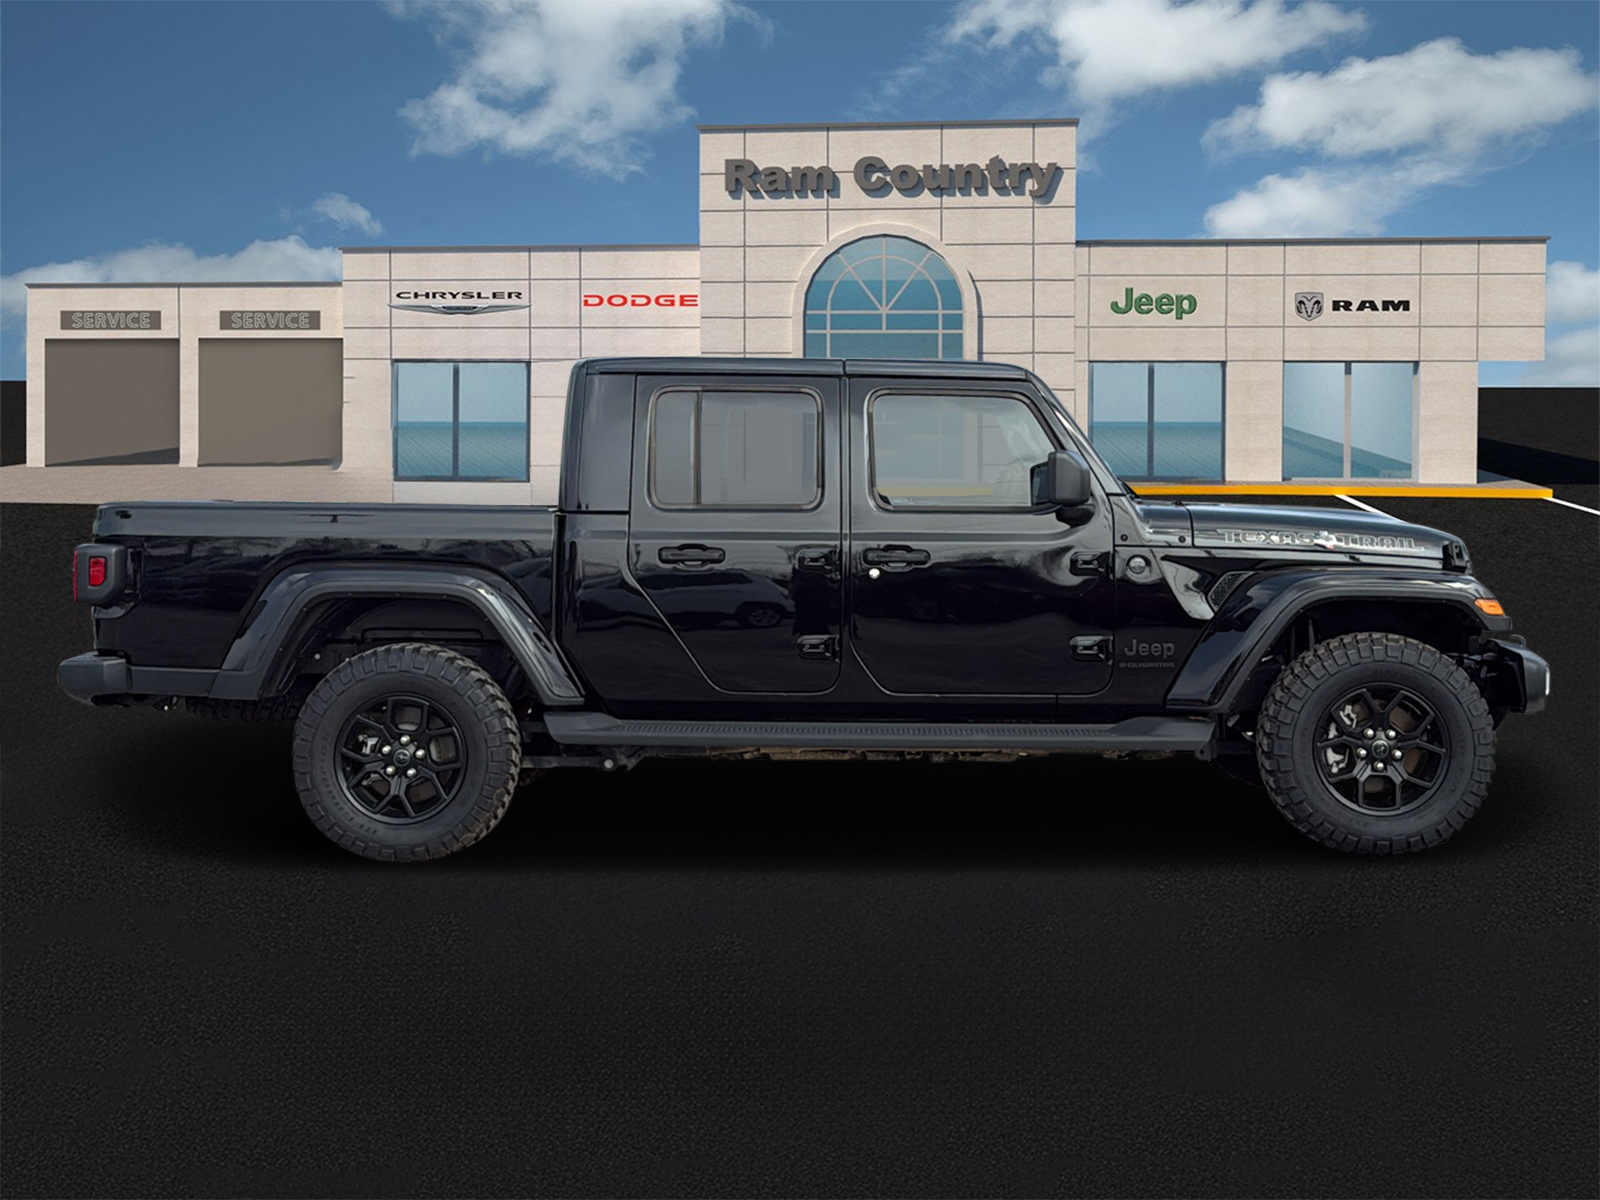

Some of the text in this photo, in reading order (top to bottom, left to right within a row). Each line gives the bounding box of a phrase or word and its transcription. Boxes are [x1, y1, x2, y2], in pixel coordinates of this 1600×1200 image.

[725, 154, 1058, 198] Ram Country
[395, 291, 523, 300] CHRYSLER
[583, 294, 699, 307] DODGE
[1110, 287, 1198, 320] Jeep
[1332, 299, 1411, 312] RAM
[71, 312, 151, 329] SERVICE
[231, 312, 310, 329] SERVICE
[1216, 528, 1425, 552] TEXAS TRAIL
[1123, 639, 1176, 659] Jeep
